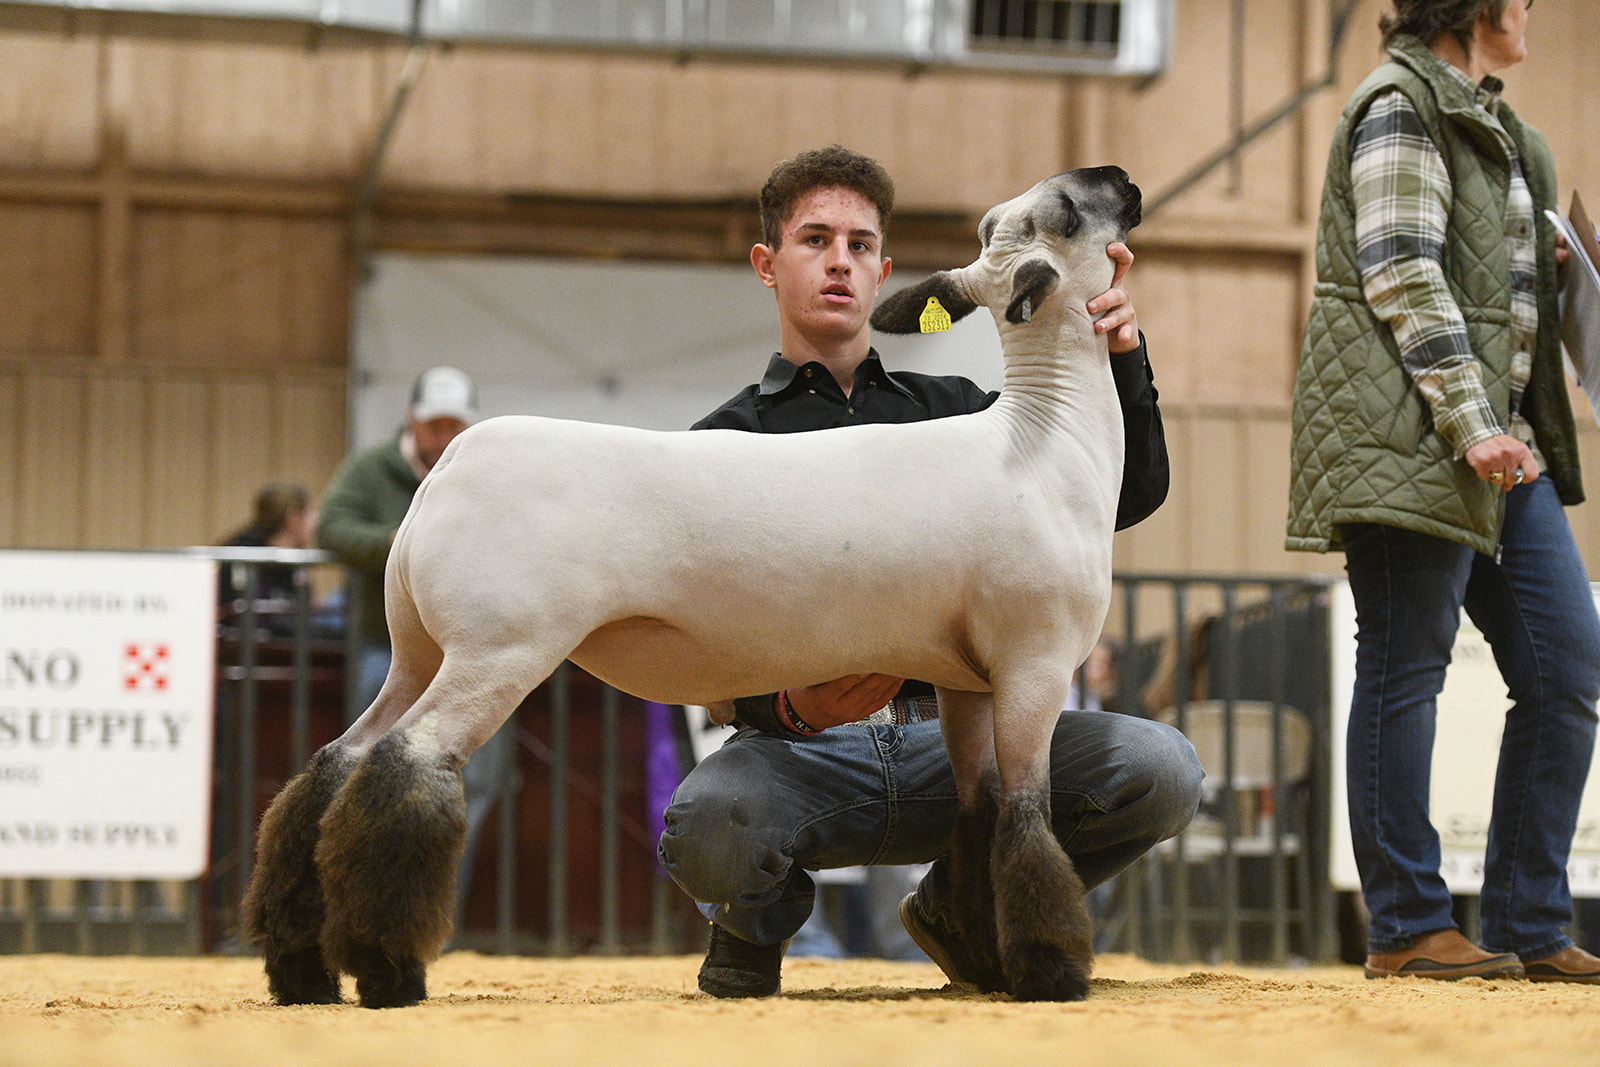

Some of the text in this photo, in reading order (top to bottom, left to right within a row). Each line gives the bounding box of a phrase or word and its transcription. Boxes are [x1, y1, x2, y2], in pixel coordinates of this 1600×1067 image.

[923, 319, 949, 331] 252313
[0, 649, 80, 691] NO
[0, 706, 190, 751] SUPPLY
